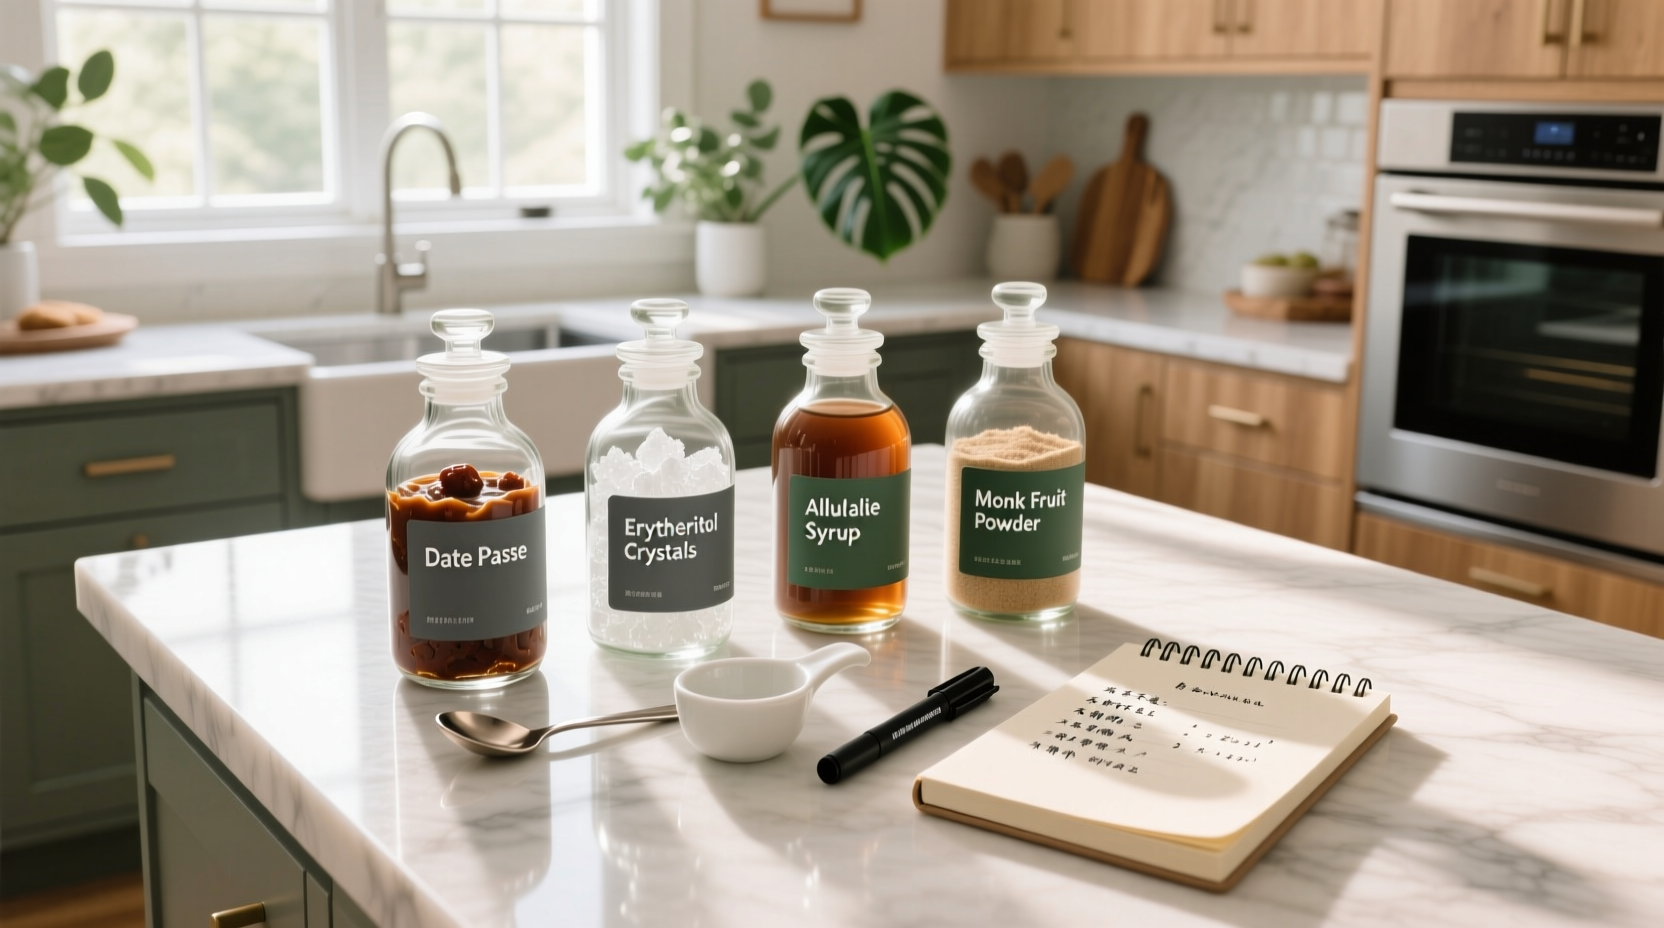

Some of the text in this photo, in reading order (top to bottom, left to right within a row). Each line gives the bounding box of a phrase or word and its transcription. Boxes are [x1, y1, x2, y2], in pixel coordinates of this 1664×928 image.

[975, 488, 1067, 509] Monk Fruit
[624, 512, 718, 542] Erytheritol
[804, 521, 861, 547] Syrup
[974, 512, 1041, 532] Powder
[425, 545, 528, 568] Date Passe
[623, 541, 698, 566] Crystals
